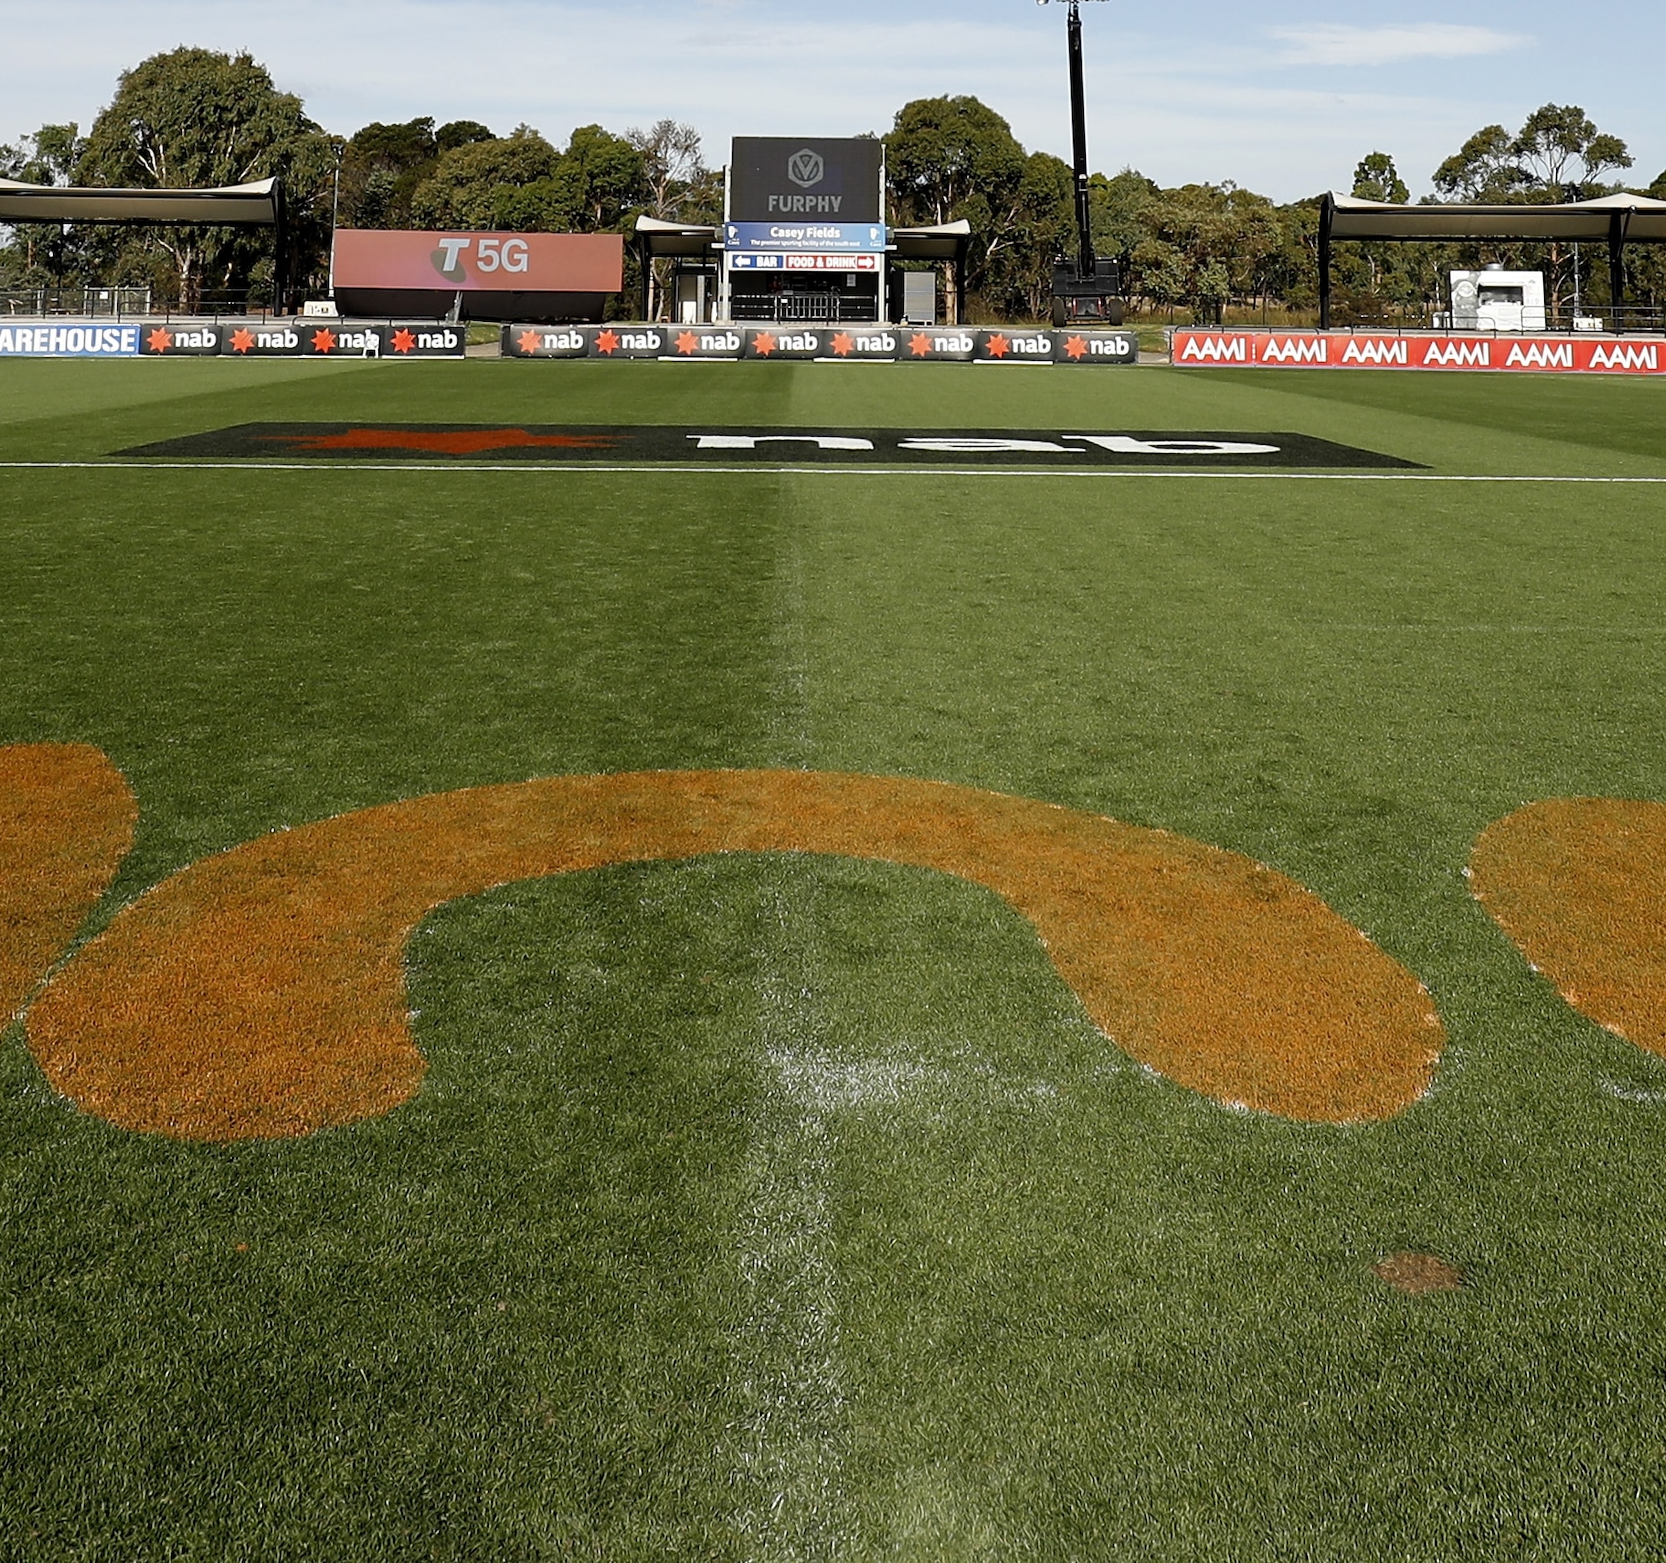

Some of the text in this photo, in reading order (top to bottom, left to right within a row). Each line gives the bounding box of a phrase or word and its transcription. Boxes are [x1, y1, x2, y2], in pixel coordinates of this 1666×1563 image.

[768, 195, 842, 213] FURPHY
[771, 224, 841, 241] Casey Fields
[476, 239, 528, 272] 5G
[756, 256, 777, 268] BAR
[788, 256, 854, 268] FOOD & DRINK
[175, 329, 217, 348] nab
[257, 328, 299, 348] nab
[417, 329, 458, 349] nab
[544, 330, 584, 349] nab
[621, 331, 661, 350] nab
[700, 331, 740, 351] nab
[778, 332, 818, 351] nab
[856, 333, 896, 352] nab
[934, 334, 974, 353] nab
[1012, 335, 1052, 354] nab
[1089, 336, 1131, 355] nab
[1181, 337, 1246, 361] AAMI
[1262, 338, 1327, 362] AAMI
[1342, 339, 1408, 364] AAMI
[1423, 341, 1490, 366] AAMI
[1505, 343, 1573, 368] AAMI
[1589, 345, 1658, 369] AAMI
[686, 435, 1281, 454] nab
